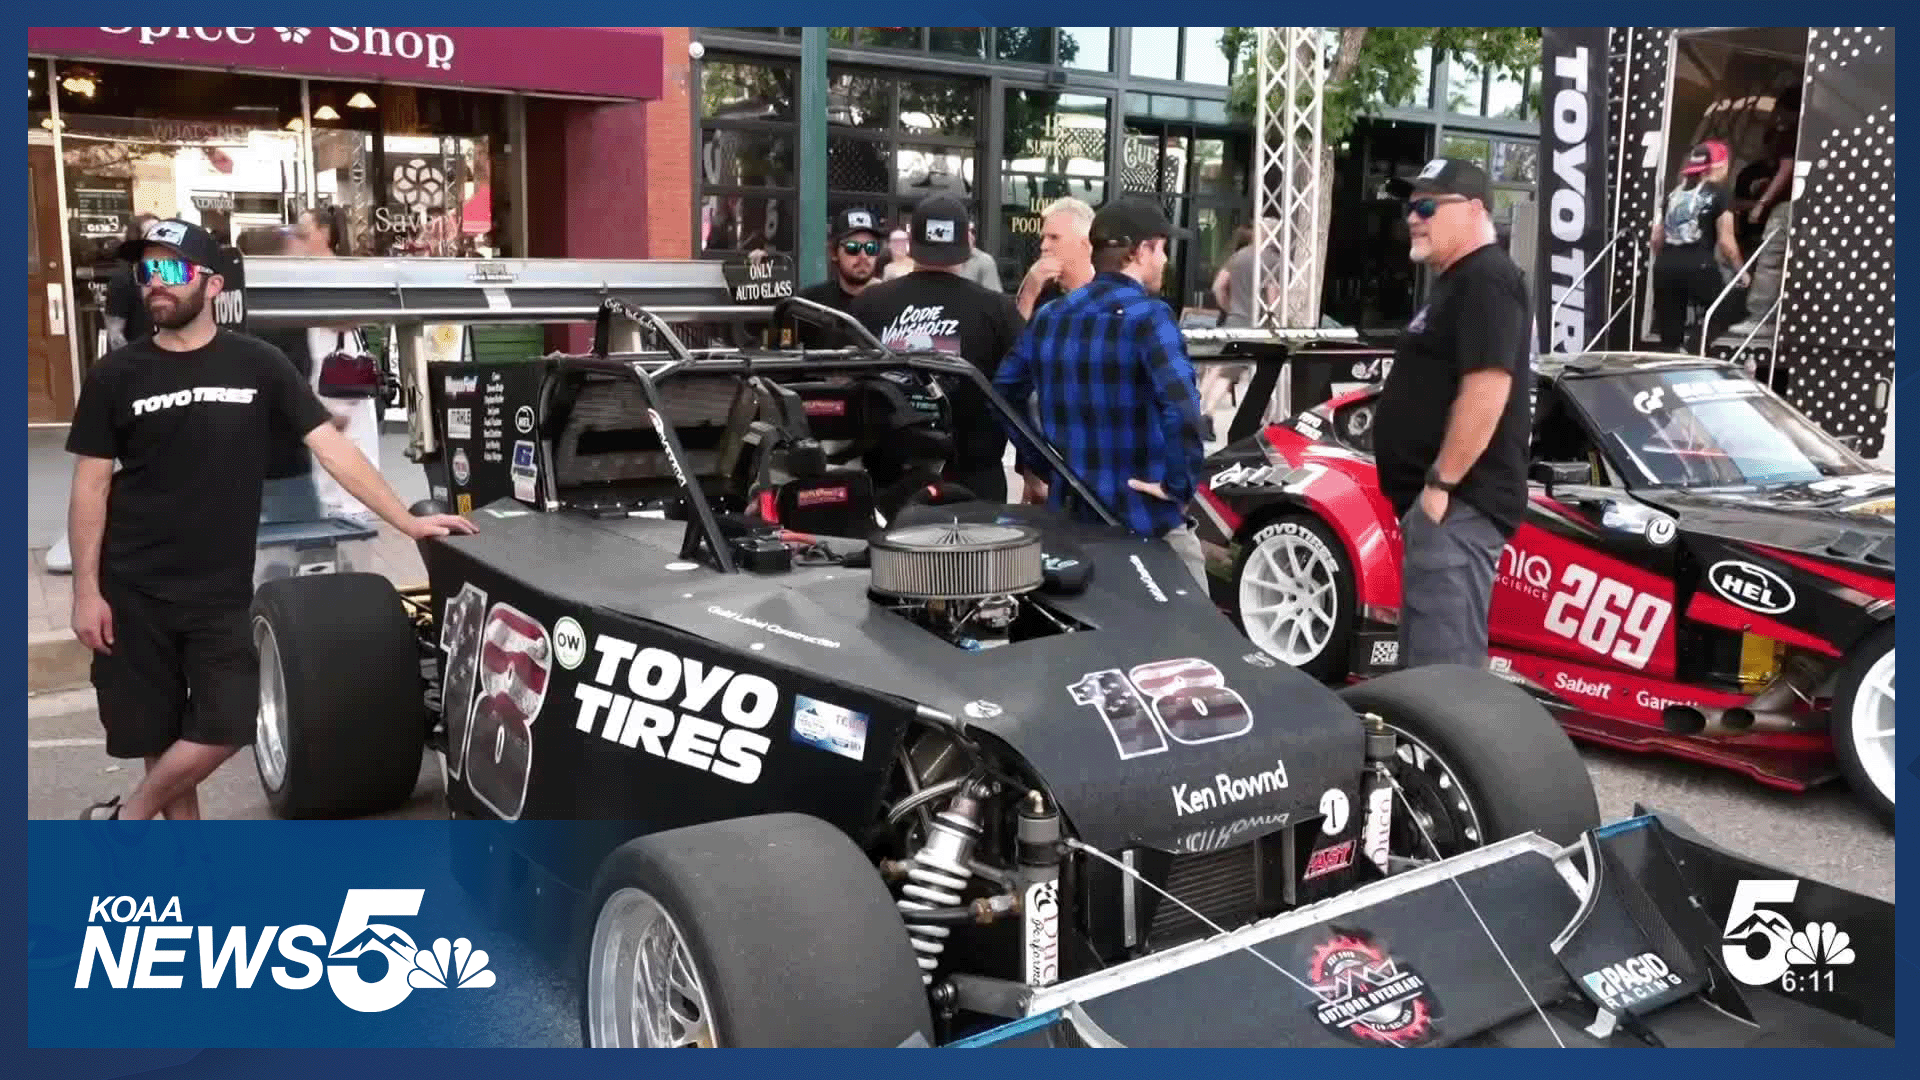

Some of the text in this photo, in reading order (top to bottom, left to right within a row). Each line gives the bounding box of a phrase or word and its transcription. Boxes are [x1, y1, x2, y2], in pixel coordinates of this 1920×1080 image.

[100, 27, 455, 70] pice Shop
[1551, 46, 1588, 242] TOYO
[735, 280, 793, 300] AUTO GLASS
[749, 261, 774, 281] ONLY
[132, 386, 258, 416] TOYO TIRES
[1253, 522, 1298, 546] TOYO
[1720, 574, 1777, 609] HEL
[1543, 563, 1672, 671] 269
[557, 632, 580, 651] OW
[594, 633, 779, 729] TOYO
[441, 582, 553, 824] 18
[1067, 658, 1255, 761] 18
[574, 682, 772, 785] TIRES
[1171, 759, 1289, 817] Ken Rownd
[1601, 952, 1669, 994] PAGID
[1318, 996, 1371, 1025] OUTDOOR
